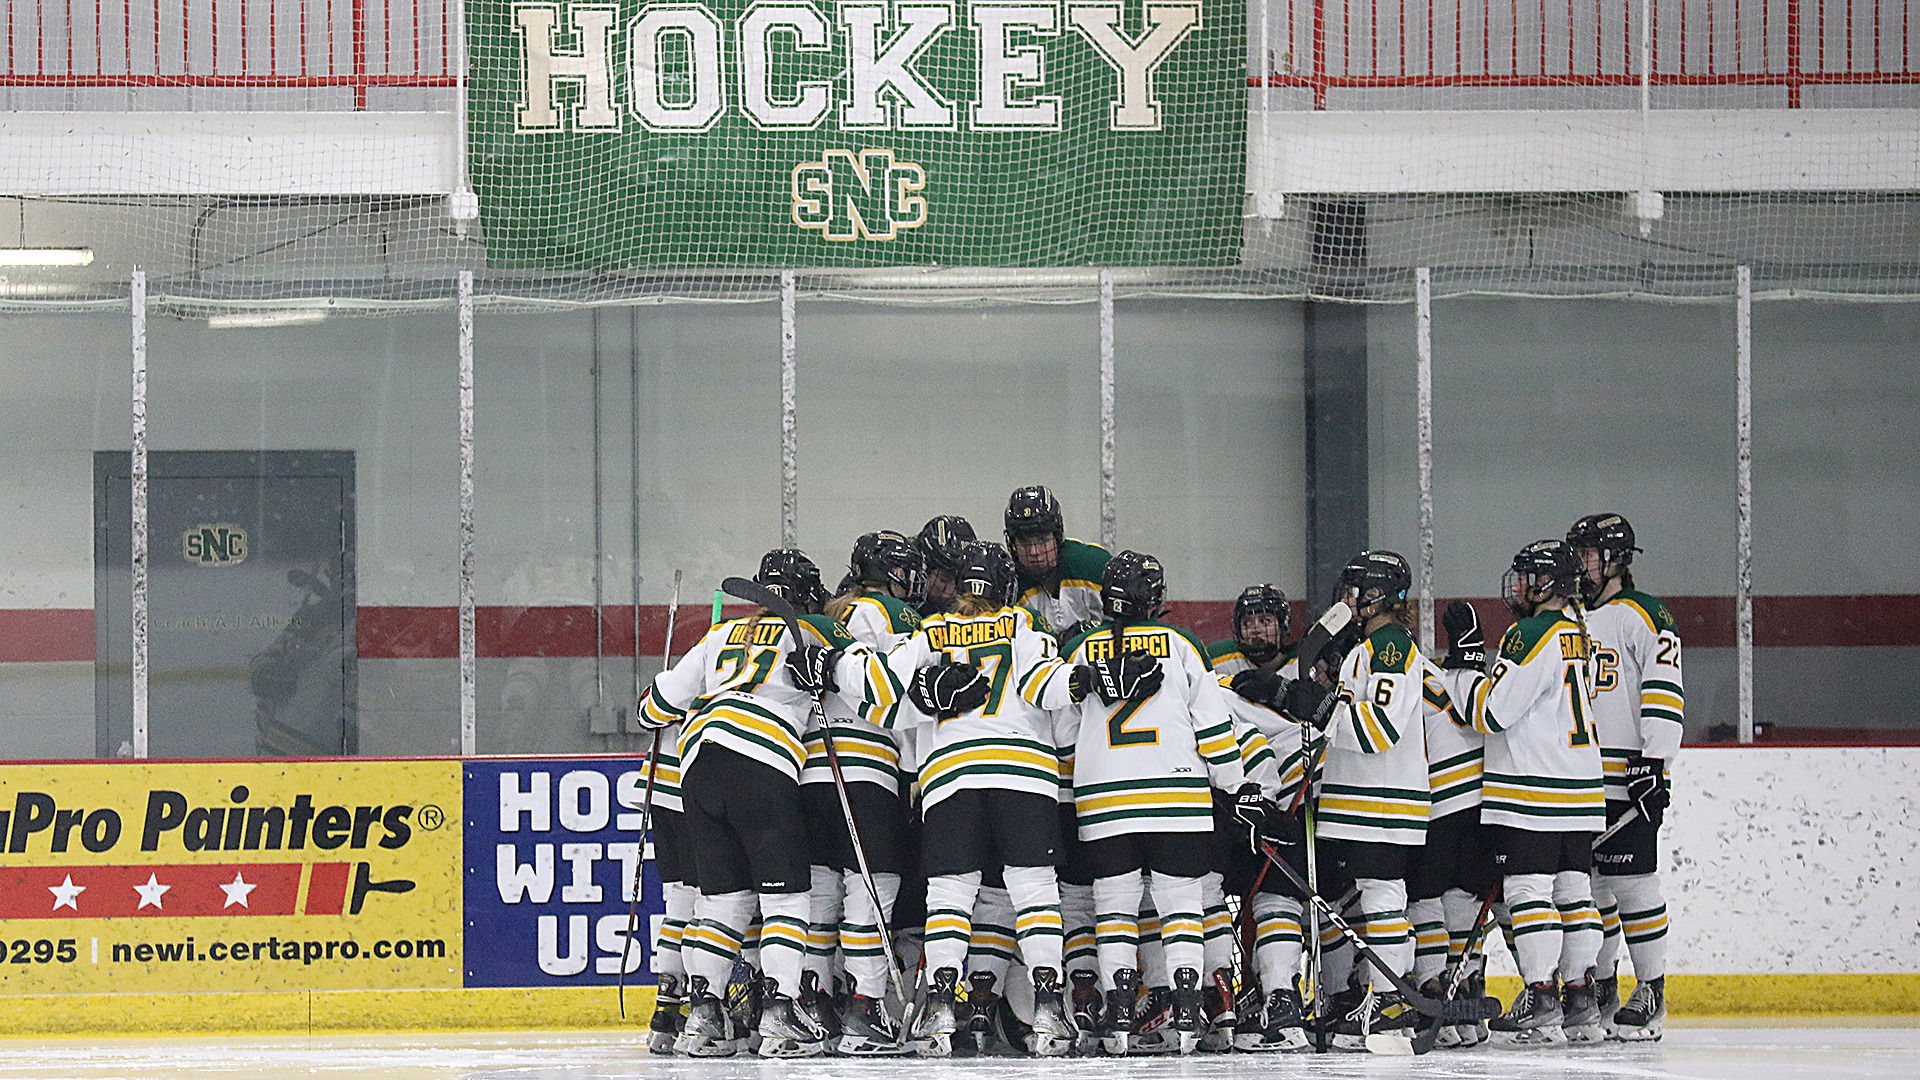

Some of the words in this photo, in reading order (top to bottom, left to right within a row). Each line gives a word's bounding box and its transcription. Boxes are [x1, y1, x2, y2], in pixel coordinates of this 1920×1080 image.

[512, 2, 1202, 133] HOCKEY
[792, 149, 927, 241] SNC
[183, 524, 248, 567] SNC
[1375, 678, 1394, 706] 6
[111, 936, 446, 966] newi.certapro.com
